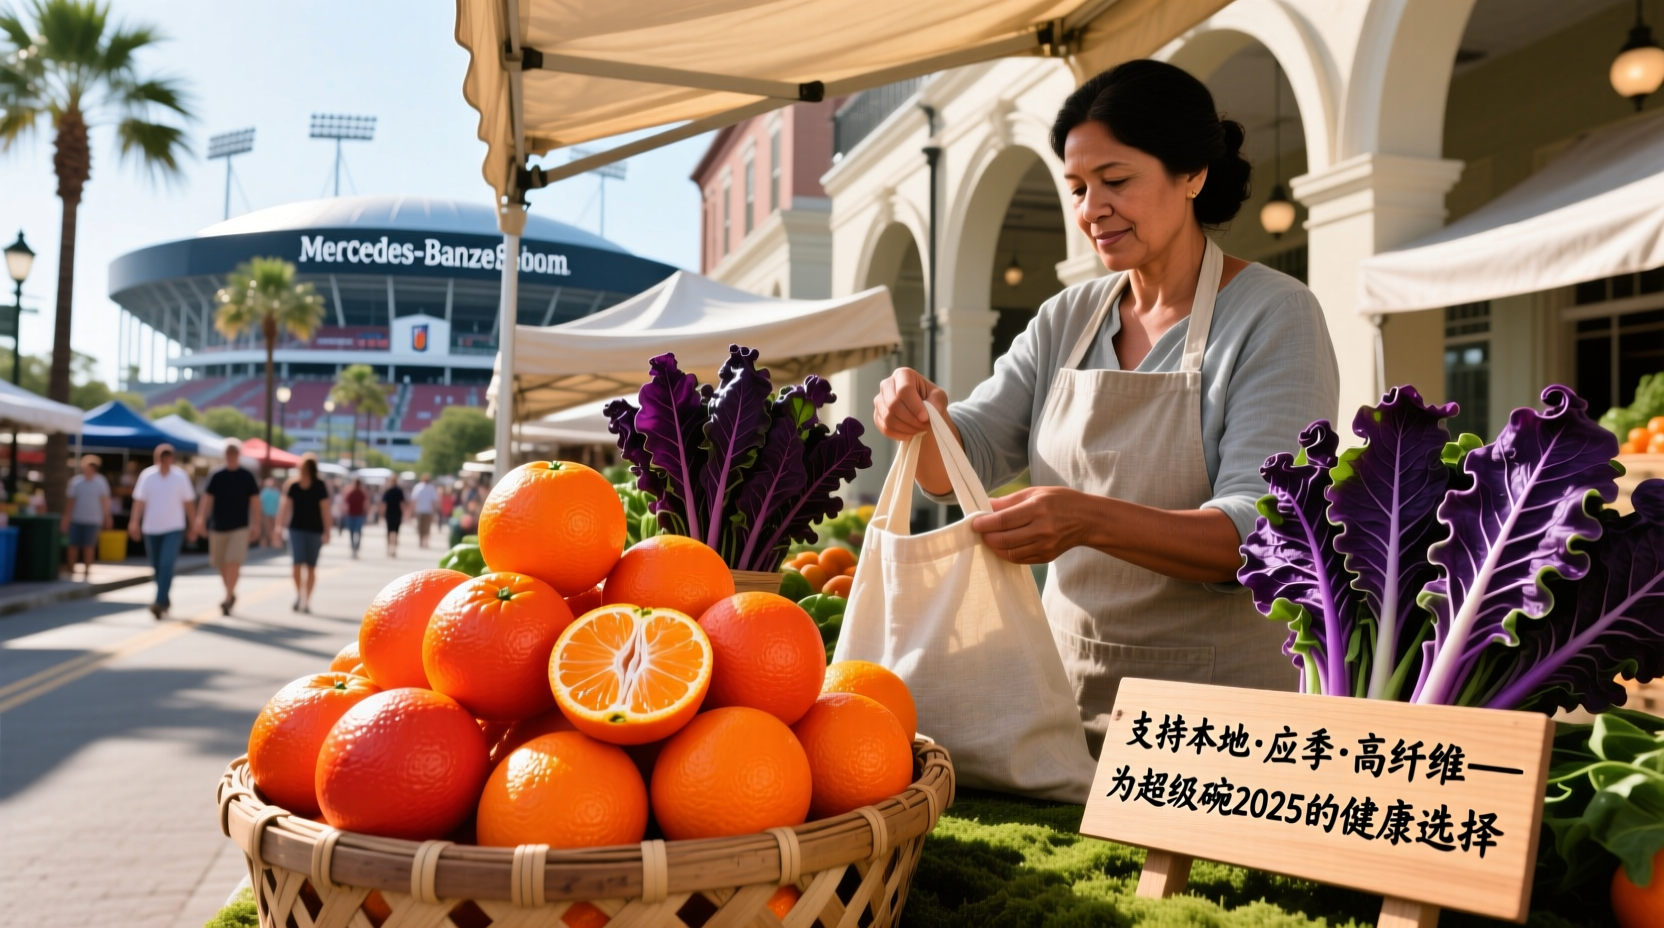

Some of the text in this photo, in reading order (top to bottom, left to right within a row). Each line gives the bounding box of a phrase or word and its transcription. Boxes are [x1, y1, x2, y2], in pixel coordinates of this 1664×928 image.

[1106, 764, 1504, 859] 为超级碗2025的健康选择
